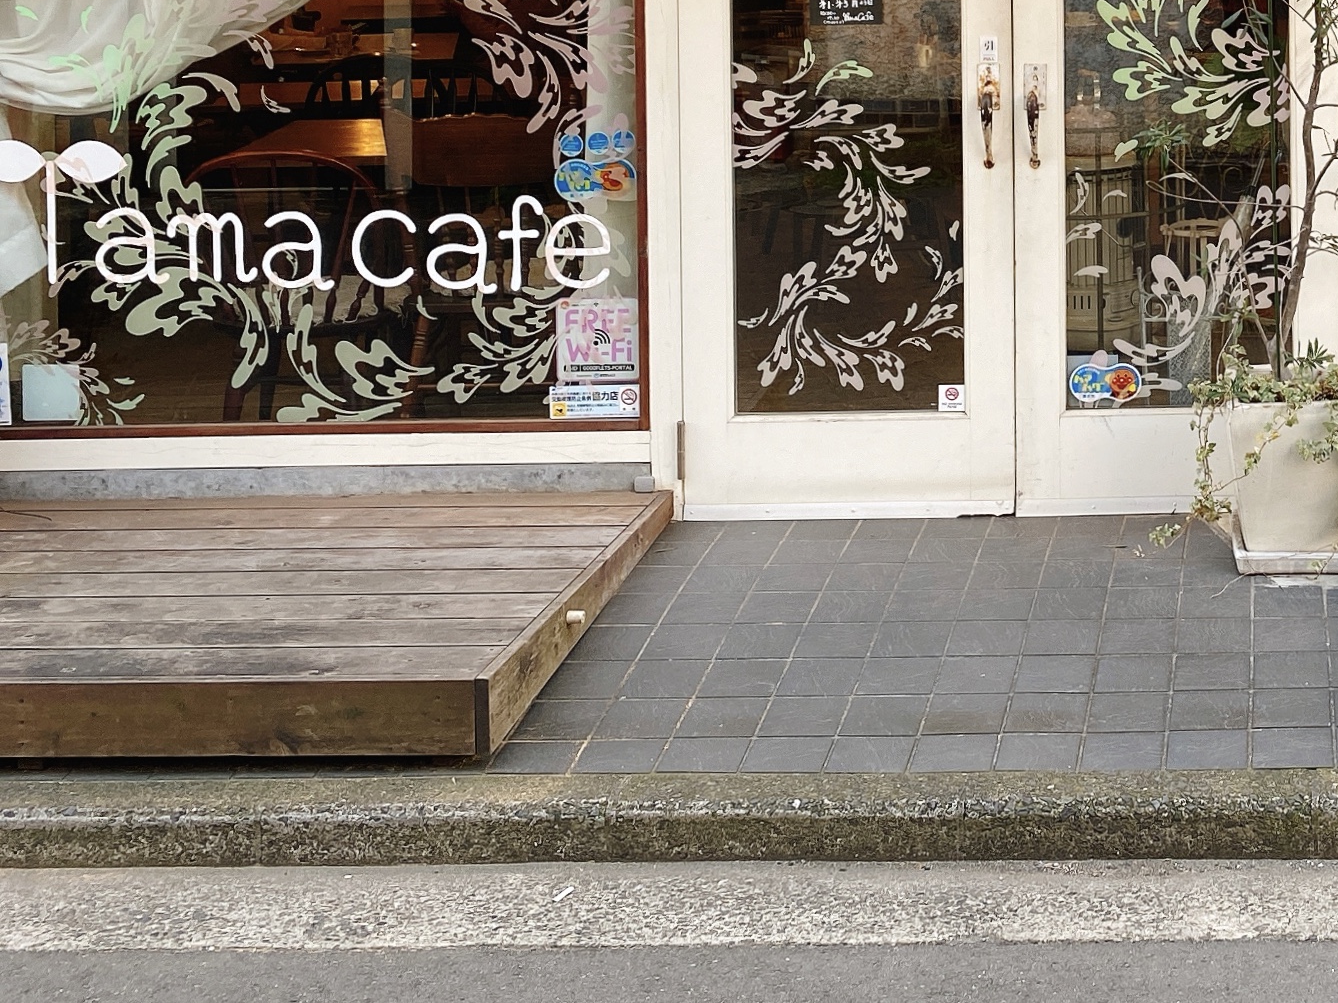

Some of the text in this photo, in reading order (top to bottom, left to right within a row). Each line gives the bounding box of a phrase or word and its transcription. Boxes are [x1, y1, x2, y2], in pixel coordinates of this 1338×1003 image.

[0, 140, 611, 294] Tama cafe
[592, 391, 619, 401] 協力店
